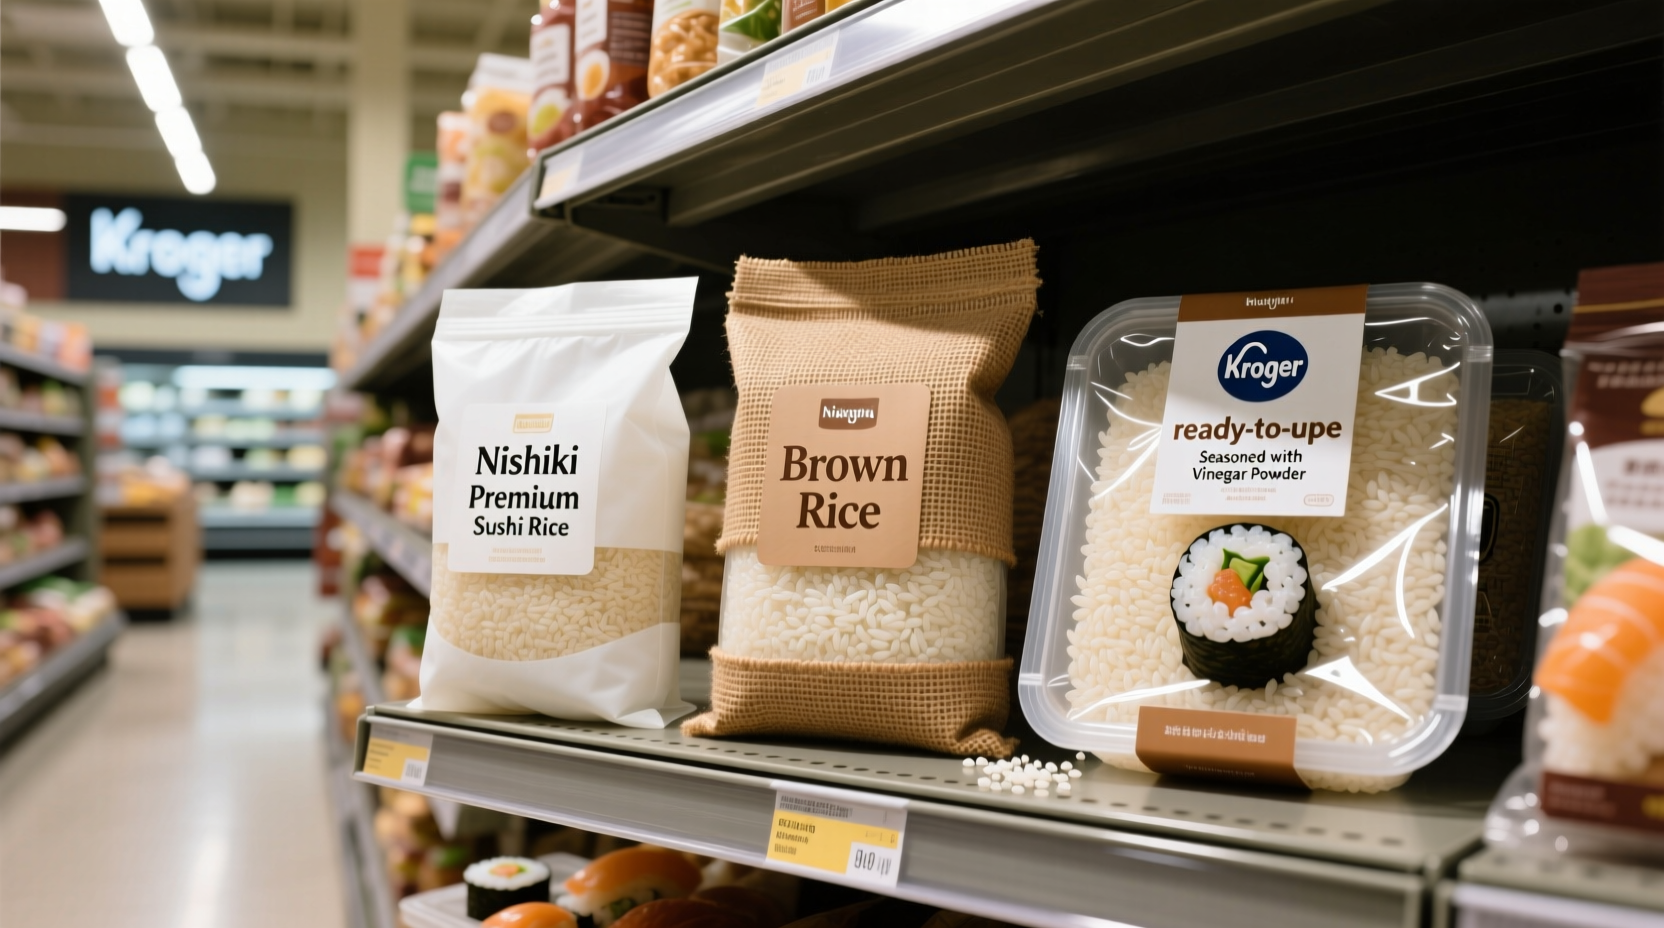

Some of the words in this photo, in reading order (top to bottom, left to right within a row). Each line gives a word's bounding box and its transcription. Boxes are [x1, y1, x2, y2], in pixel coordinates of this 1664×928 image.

[88, 207, 273, 302] Kroger
[1223, 340, 1304, 389] Kroger
[1173, 416, 1343, 446] ready-to-upe
[475, 444, 579, 476] Nishiki
[780, 445, 909, 483] Brown
[1199, 449, 1266, 464] Seasoned
[1270, 448, 1303, 463] with
[1192, 466, 1248, 485] Vinegar
[1251, 466, 1307, 481] Powder
[468, 484, 579, 510] Premium
[796, 492, 881, 530] Rice
[473, 515, 523, 536] Sushi
[528, 516, 570, 537] Rice
